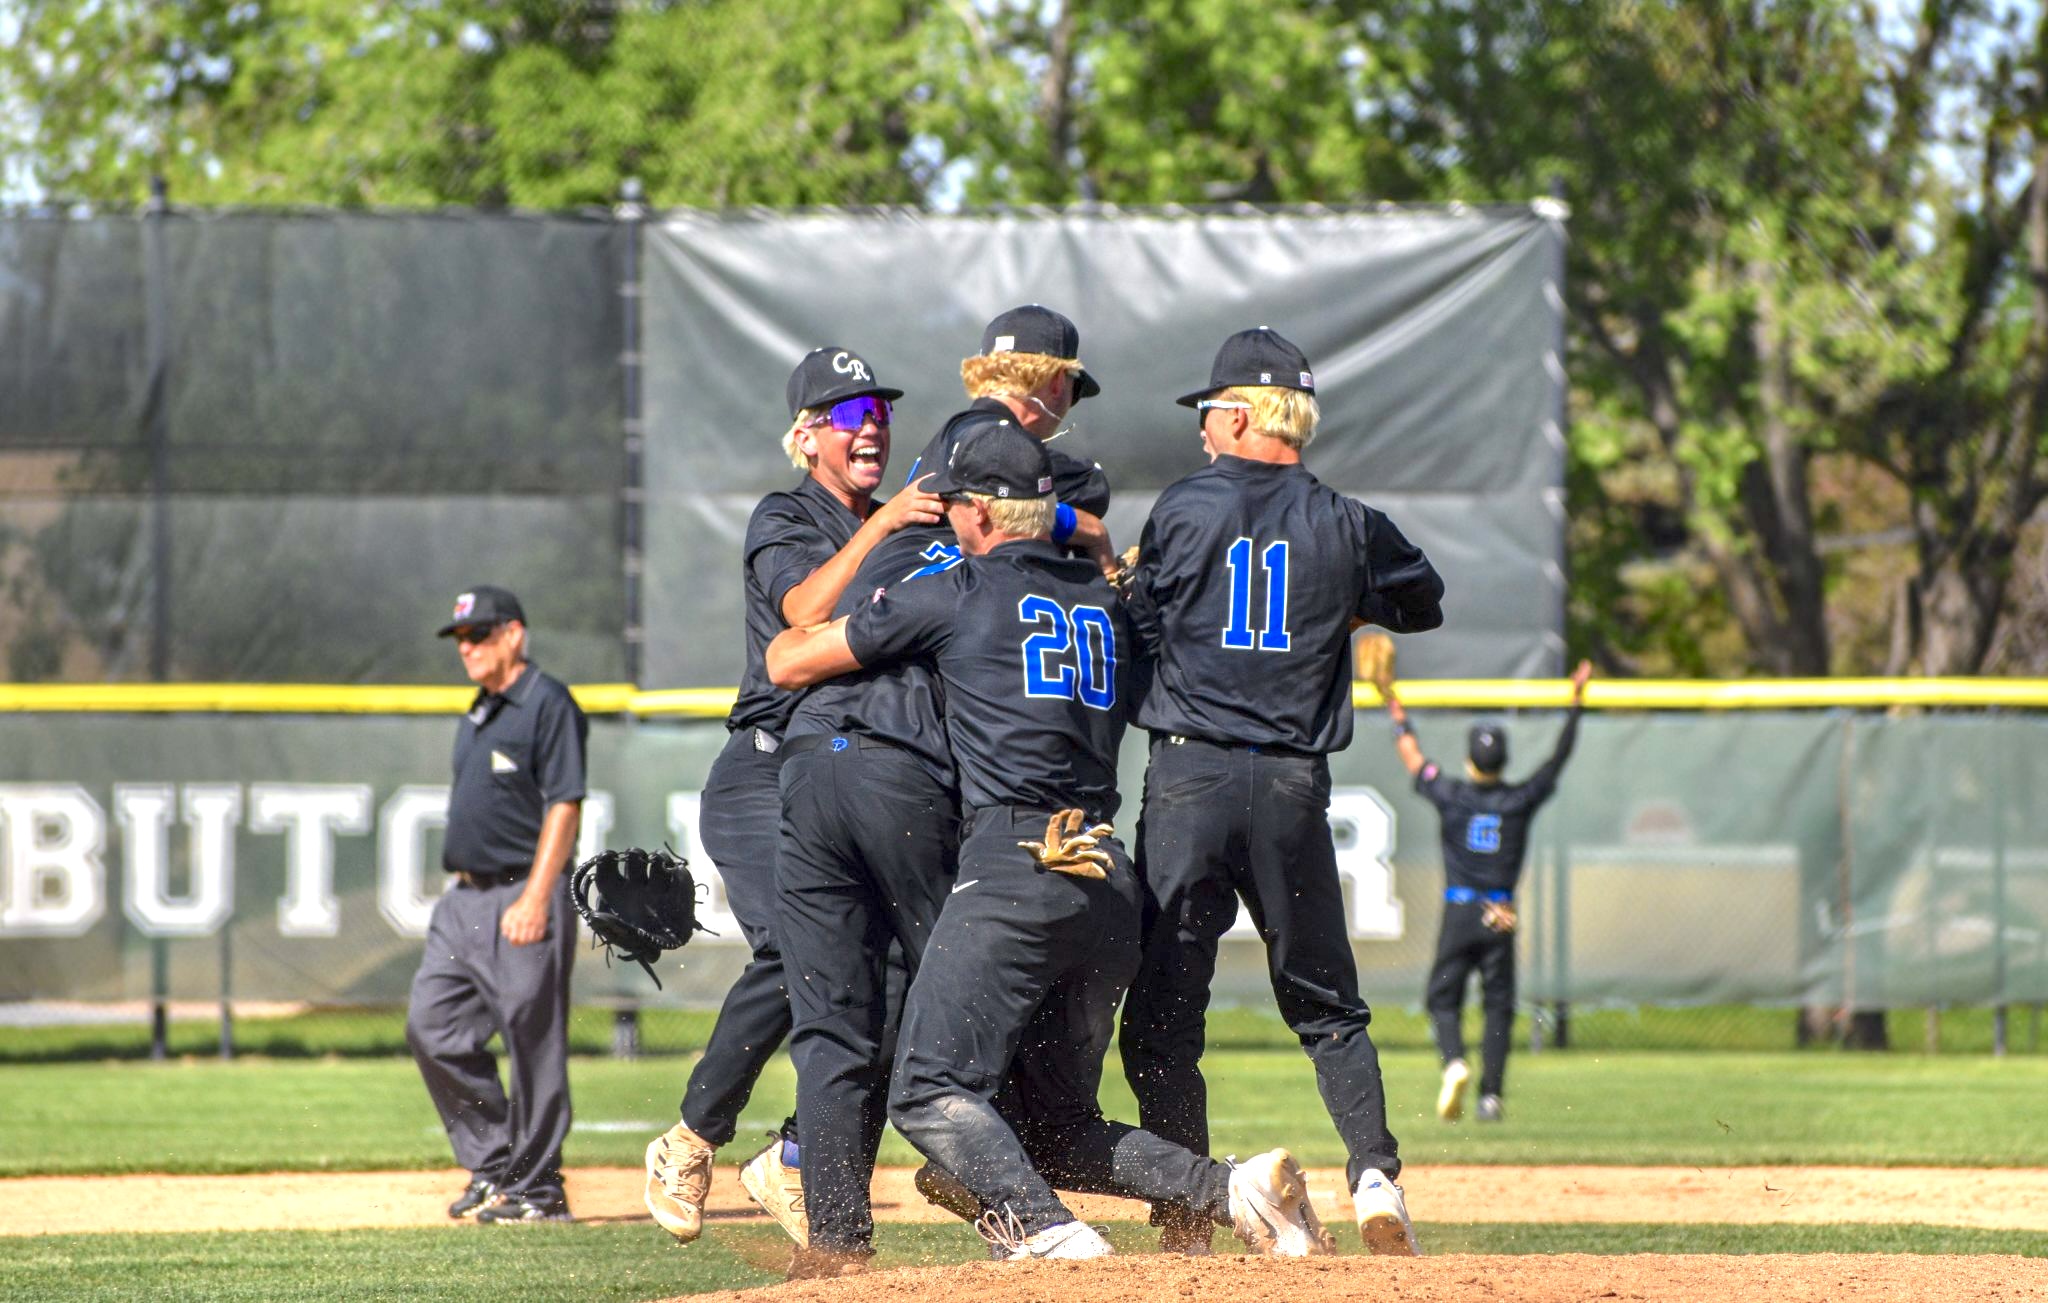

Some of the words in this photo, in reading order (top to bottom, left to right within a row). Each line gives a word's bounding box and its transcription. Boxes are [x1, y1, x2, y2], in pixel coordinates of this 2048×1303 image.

[832, 351, 871, 381] CR
[1018, 593, 1117, 711] 20
[1220, 536, 1292, 653] 11
